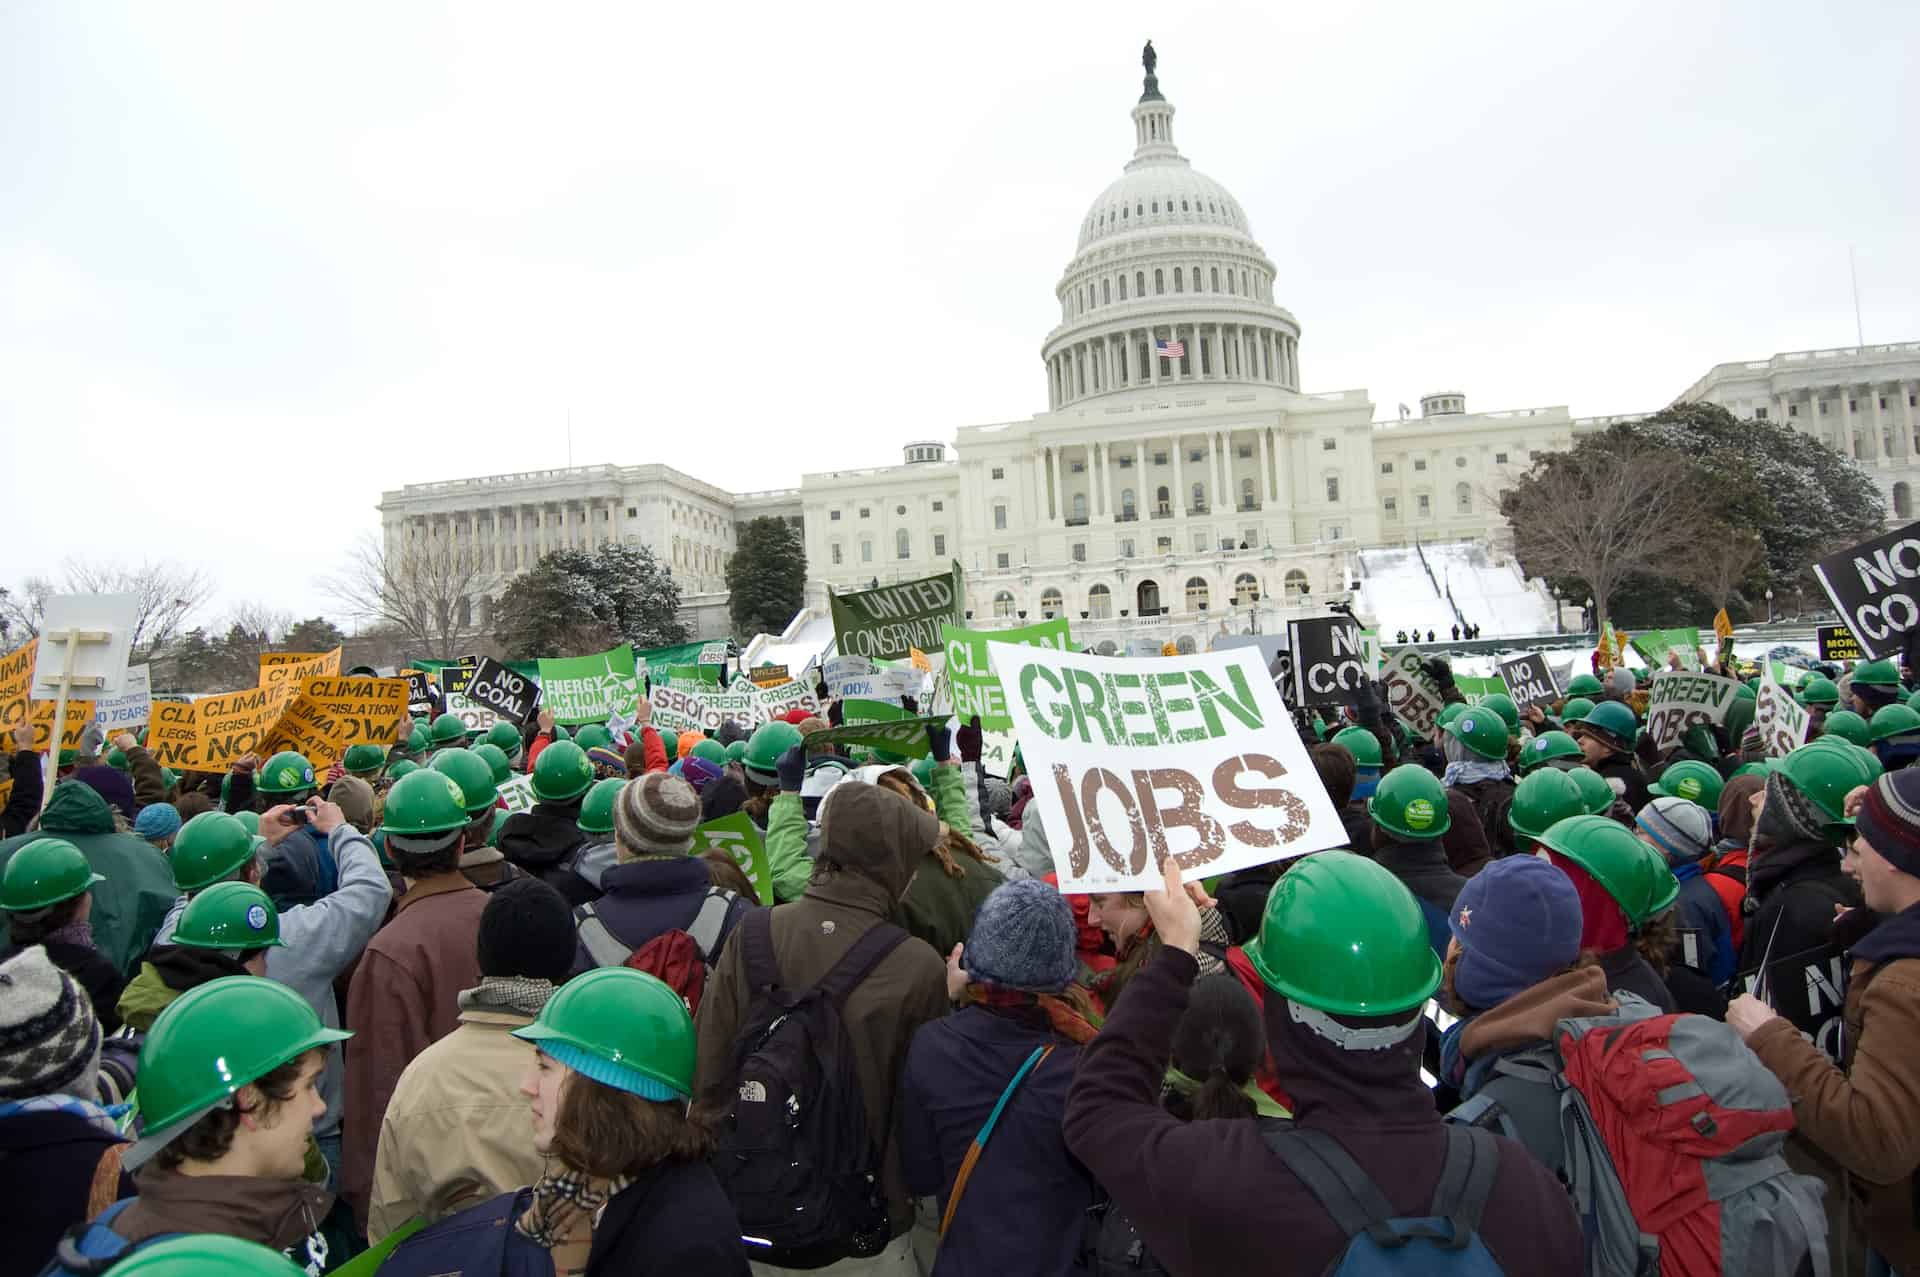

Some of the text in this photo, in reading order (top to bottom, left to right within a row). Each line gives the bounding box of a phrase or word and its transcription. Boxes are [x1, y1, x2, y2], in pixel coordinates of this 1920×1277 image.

[1853, 538, 1920, 594] NO
[860, 580, 952, 619] UNITED
[1856, 593, 1919, 640] CO
[1827, 639, 1857, 648] MOR
[408, 677, 417, 688] O
[463, 670, 473, 679] N
[494, 670, 524, 694] NO
[1308, 660, 1362, 693] CO
[1510, 662, 1532, 684] NO
[309, 681, 402, 699] CLIMATE
[408, 687, 426, 700] AL
[546, 675, 603, 696] ENERGY
[760, 679, 809, 704] GREEN
[1511, 679, 1553, 705] COAL
[1652, 676, 1730, 708] GREEN
[203, 682, 283, 717] CLIMATE
[320, 703, 399, 715] GISLATION
[475, 681, 524, 718] COAL
[548, 689, 605, 709] ACTION
[954, 681, 1007, 717] ENE
[1019, 664, 1265, 748] GREEN
[160, 706, 196, 724] CLI
[461, 711, 496, 729] OB
[705, 711, 751, 728] OBS
[1650, 708, 1712, 745] OB
[343, 718, 400, 741] OW
[154, 741, 198, 765] NO
[206, 728, 266, 761] NO
[1051, 753, 1311, 880] JOBS
